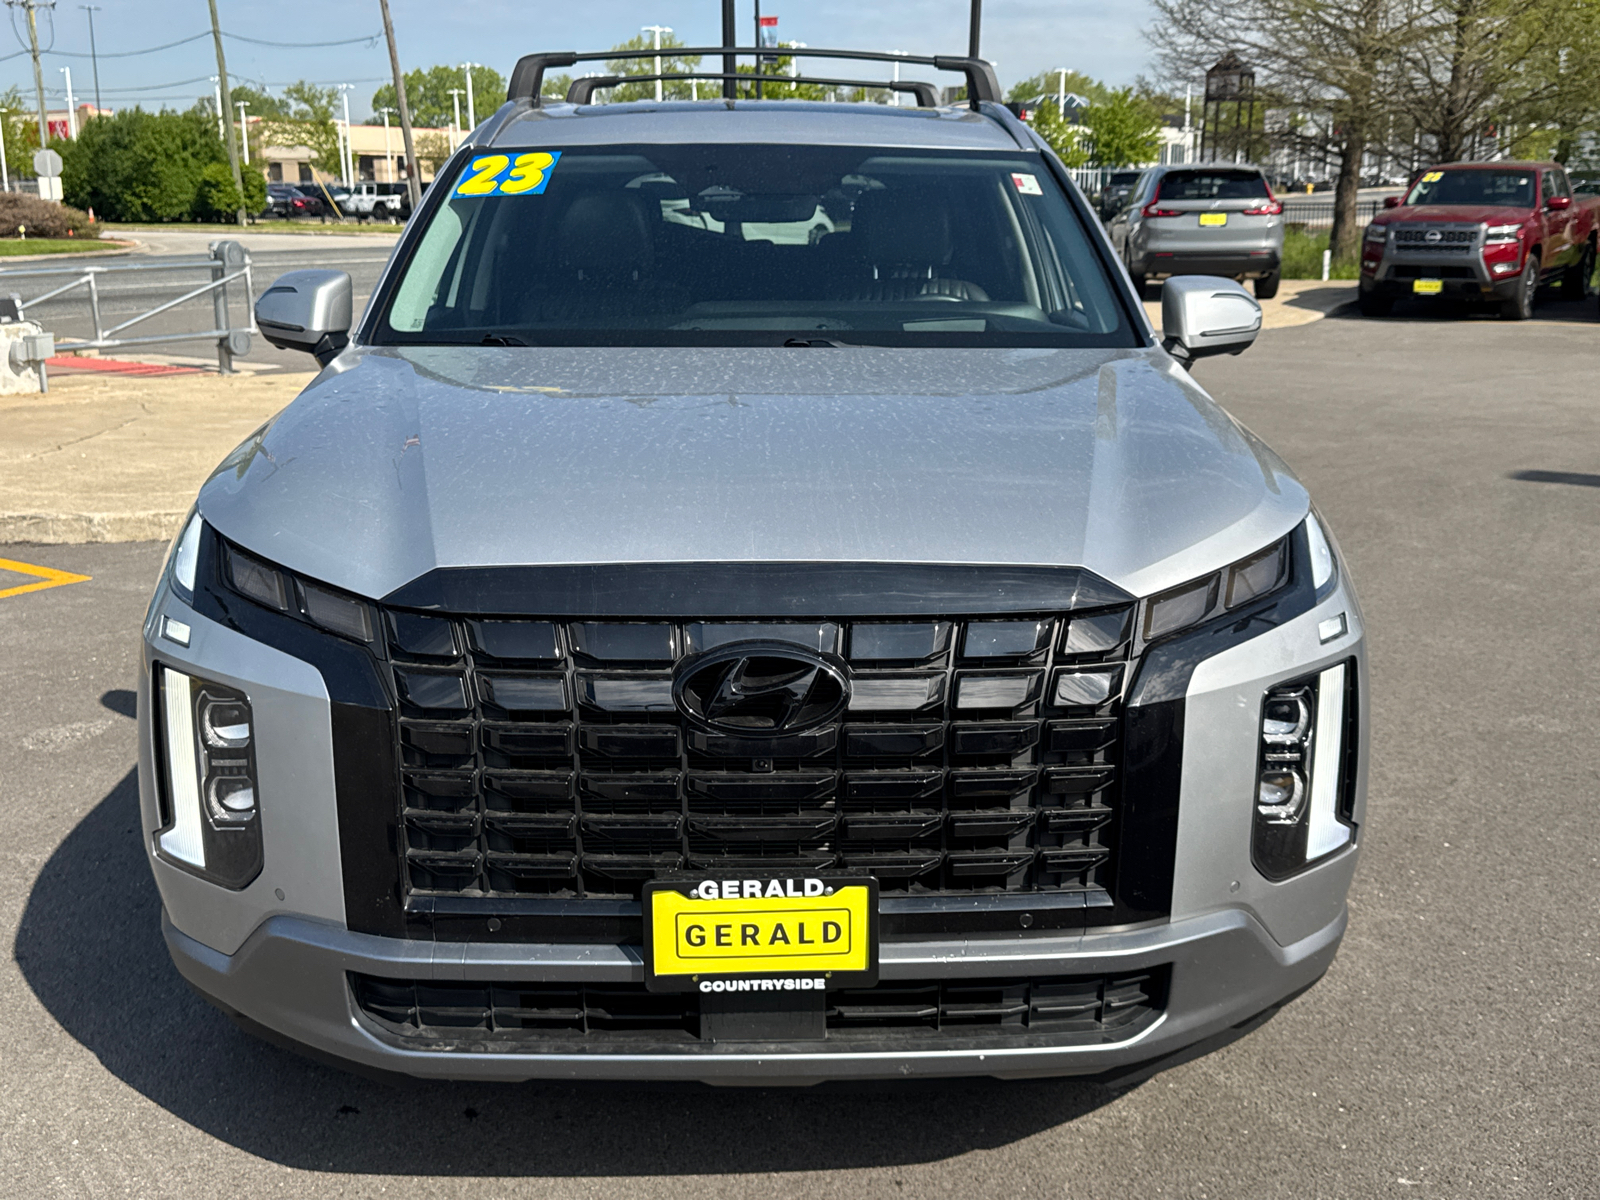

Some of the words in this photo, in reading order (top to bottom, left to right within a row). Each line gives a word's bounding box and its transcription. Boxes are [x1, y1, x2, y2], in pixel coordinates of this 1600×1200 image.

[456, 151, 555, 195] 23
[698, 878, 825, 900] GERALD
[685, 921, 842, 947] GERALD
[699, 978, 826, 993] COUNTRYSIDE
